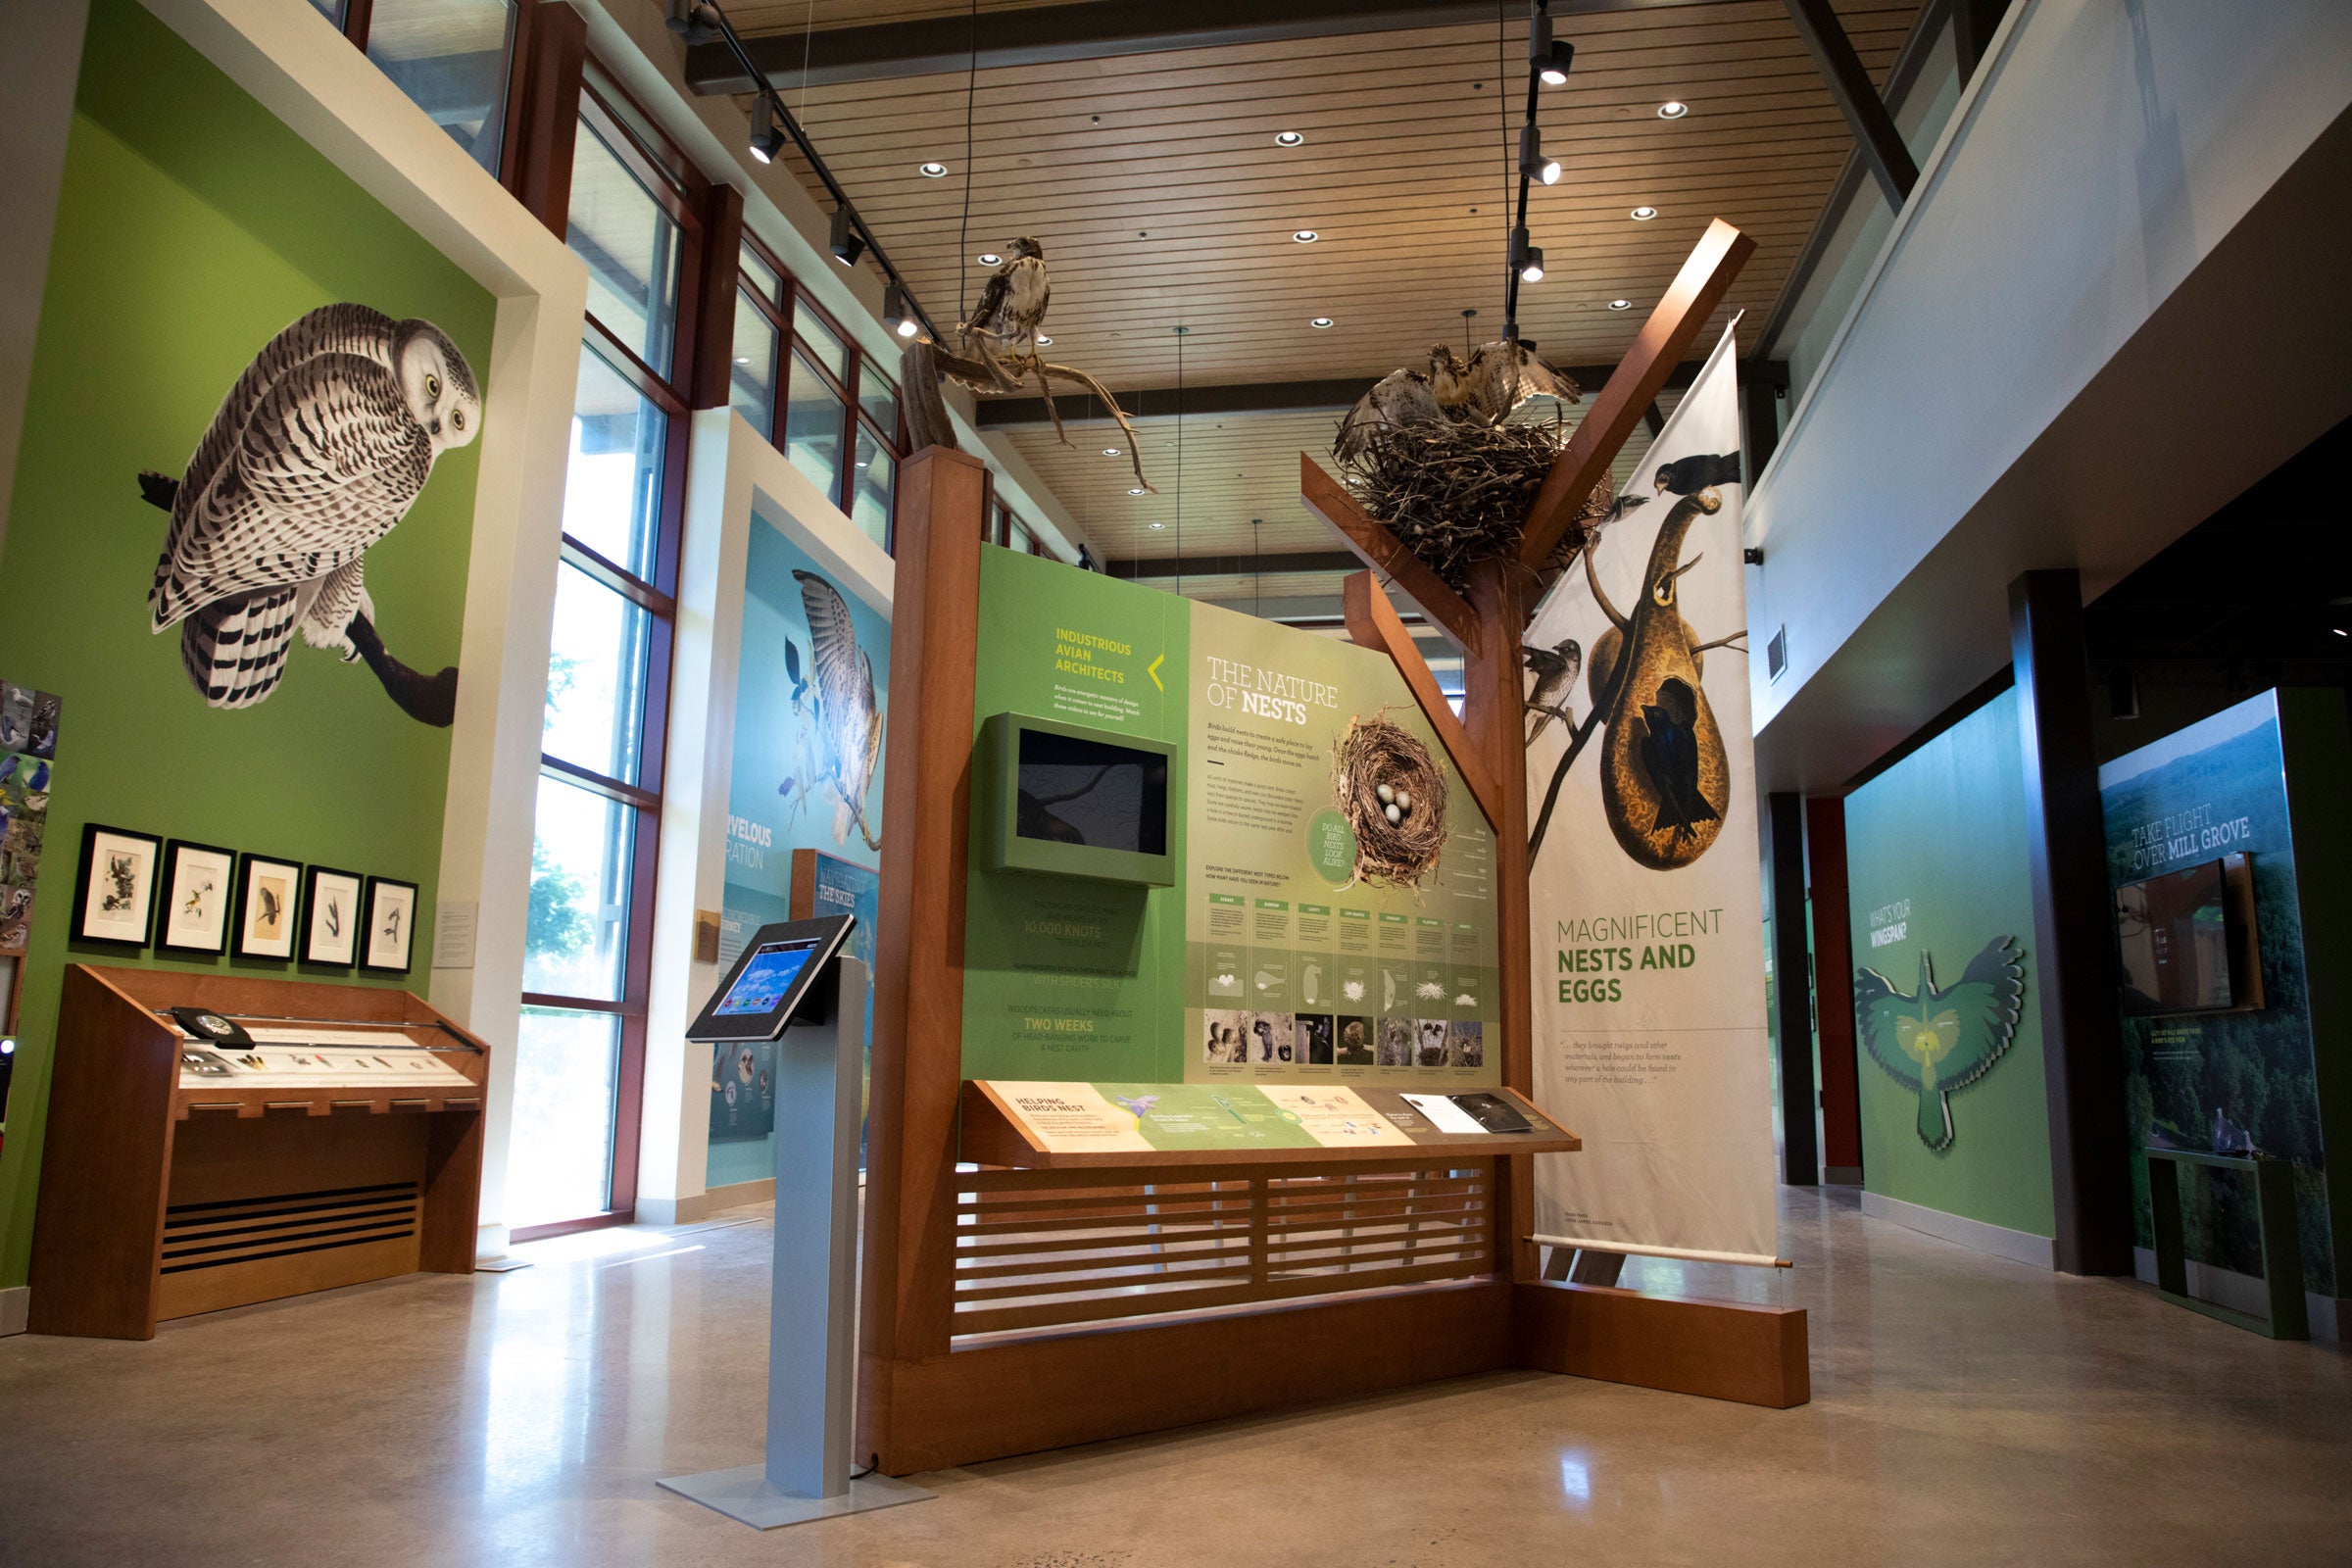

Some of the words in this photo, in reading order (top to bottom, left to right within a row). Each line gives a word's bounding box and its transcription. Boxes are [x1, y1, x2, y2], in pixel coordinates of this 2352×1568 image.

[1055, 628, 1132, 656] INDUSTRIOUS
[1055, 644, 1092, 662] AVIAN
[1055, 660, 1125, 684] ARCHITECTS
[1207, 657, 1251, 688] THE
[1256, 668, 1338, 709] NATURE
[1207, 683, 1238, 709] OF
[1242, 691, 1306, 725] NESTS
[1207, 721, 1221, 730] Birds
[1221, 724, 1235, 733] build
[1306, 752, 1319, 760] hatch
[1322, 823, 1333, 832] DO
[1333, 825, 1345, 834] ALL
[2131, 820, 2162, 848] TAKE
[2164, 804, 2212, 839] FLIGHT
[1326, 832, 1342, 842] BIRD
[2133, 845, 2167, 870] OVER
[2169, 833, 2199, 860] MILL
[2201, 816, 2251, 850] GROVE
[1324, 841, 1345, 851] NESTS
[1325, 849, 1343, 858] LOOK
[1323, 858, 1346, 867] ALIKE?
[819, 884, 835, 903] THE
[835, 889, 856, 908] SKIES
[1891, 899, 1911, 920] YOUR
[1025, 921, 1061, 935] 10,000
[1064, 924, 1102, 938] KNOTS
[1558, 909, 1723, 943] MAGNIFICENT
[1871, 922, 1907, 948] WINGSPAN?
[1558, 948, 1633, 972] NESTS
[1640, 944, 1695, 969] AND
[1034, 974, 1058, 985] WITH
[1558, 978, 1622, 1003] EGGS
[1007, 1004, 1060, 1014] WOODPECKERS
[1062, 1006, 1091, 1015] USUALLY
[1024, 1017, 1052, 1030] TWO
[1054, 1019, 1094, 1032] WEEKS
[1023, 1032, 1076, 1041] HEAD-BANGING
[1572, 1040, 1587, 1050] they
[1588, 1041, 1613, 1050] brought
[1614, 1041, 1633, 1050] twigs
[1612, 1053, 1634, 1061] began
